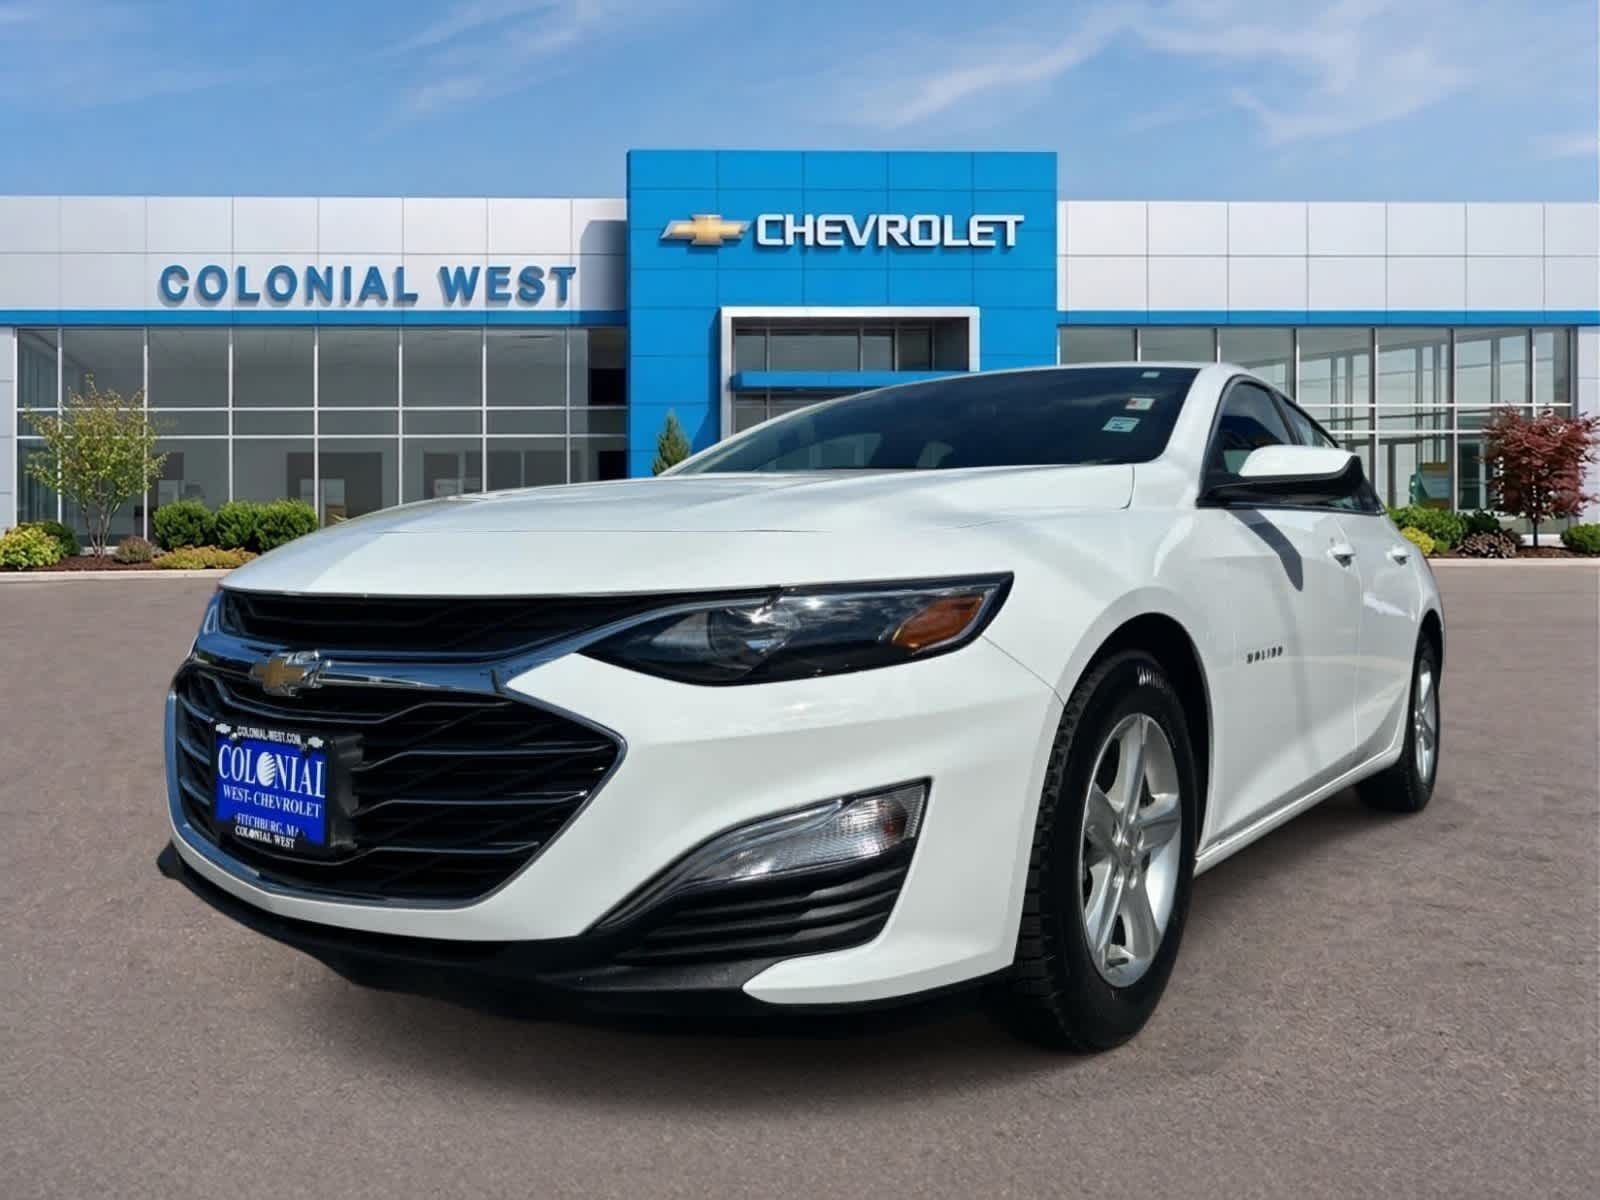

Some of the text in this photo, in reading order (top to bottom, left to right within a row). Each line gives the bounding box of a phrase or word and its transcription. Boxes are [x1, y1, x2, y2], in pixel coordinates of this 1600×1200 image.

[756, 213, 1025, 248] CHEVROLET
[158, 264, 577, 307] COLONIAL WEST
[217, 744, 326, 799] COLONIAL
[234, 825, 296, 849] COLONIAL WEST
